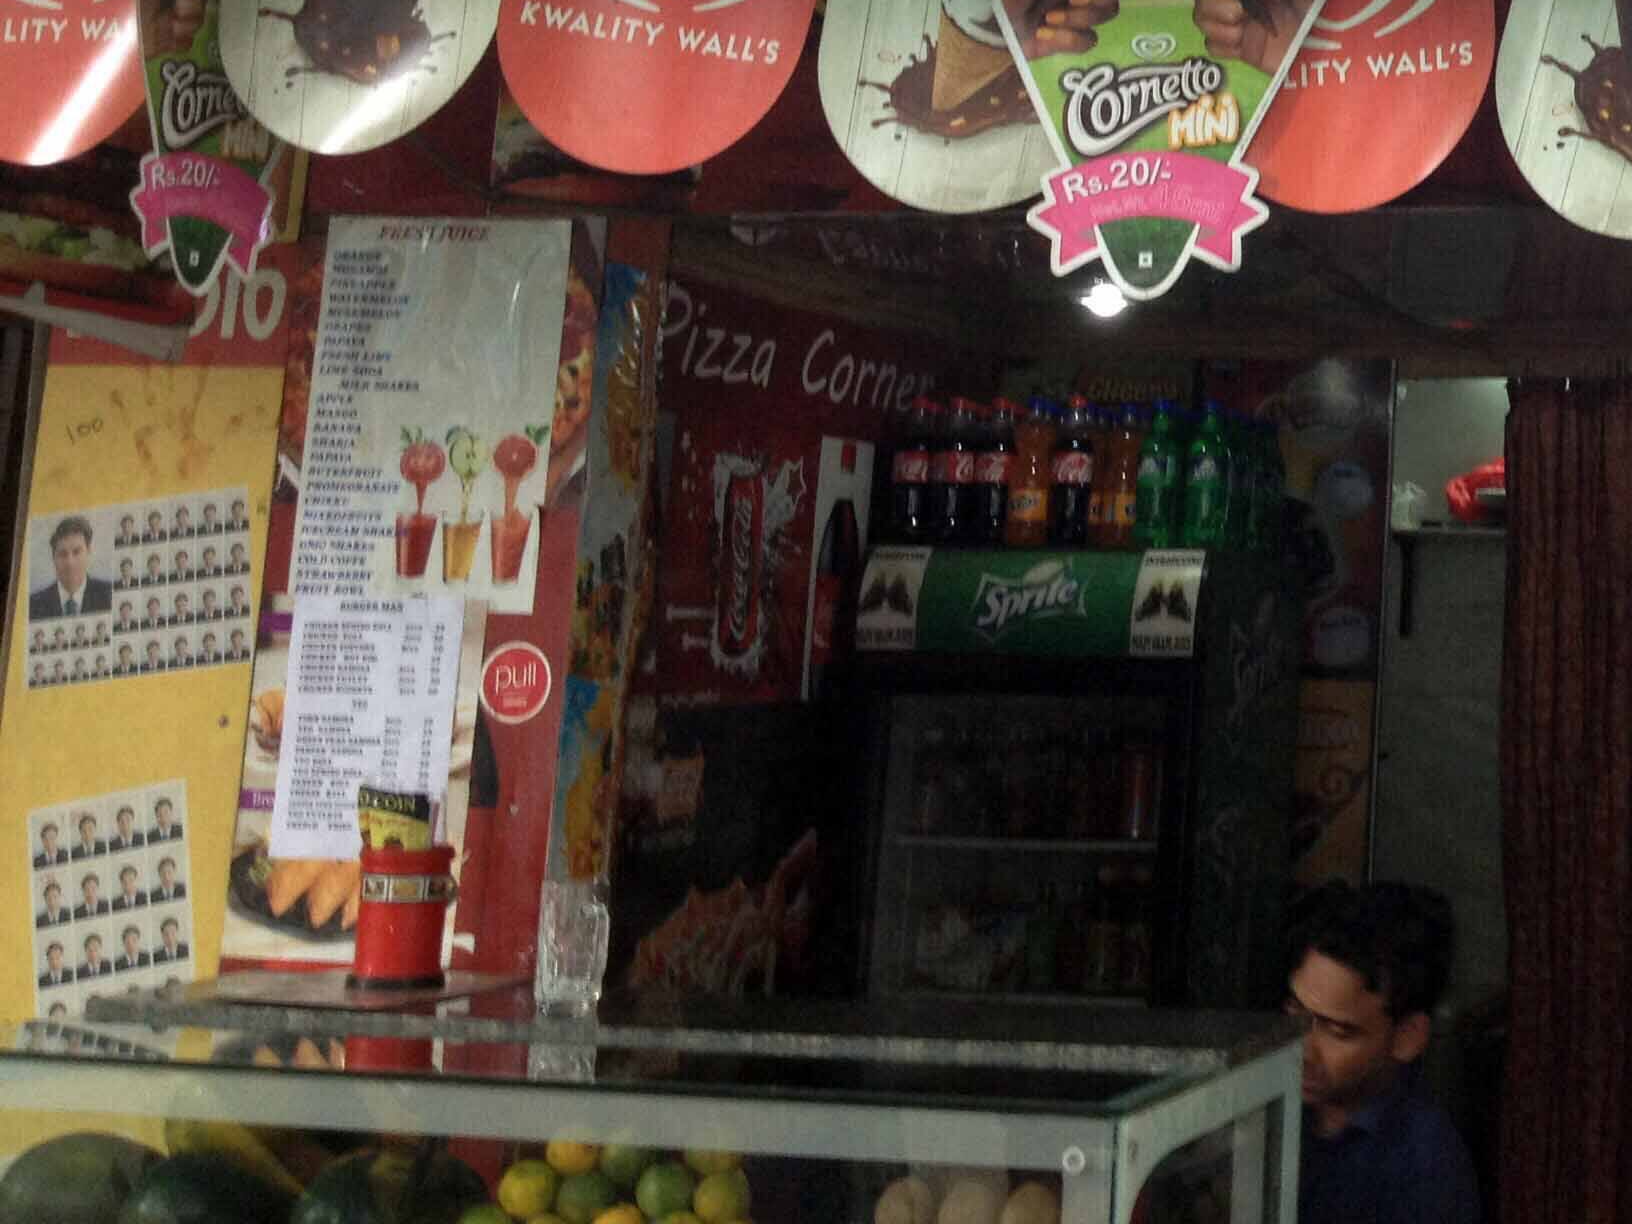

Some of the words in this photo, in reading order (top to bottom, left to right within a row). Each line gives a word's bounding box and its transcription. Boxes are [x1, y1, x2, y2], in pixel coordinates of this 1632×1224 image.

[3, 17, 68, 43] LITY
[677, 21, 781, 66] WALL'S
[1284, 58, 1351, 91] LITY
[1366, 41, 1475, 76] WALL'S
[161, 60, 245, 150] Corne
[1062, 58, 1223, 157] Cornetto
[1061, 156, 1173, 204] Rs.20/-
[658, 282, 777, 388] Pizza
[975, 570, 1081, 634] Sprite
[494, 663, 537, 696] pull
